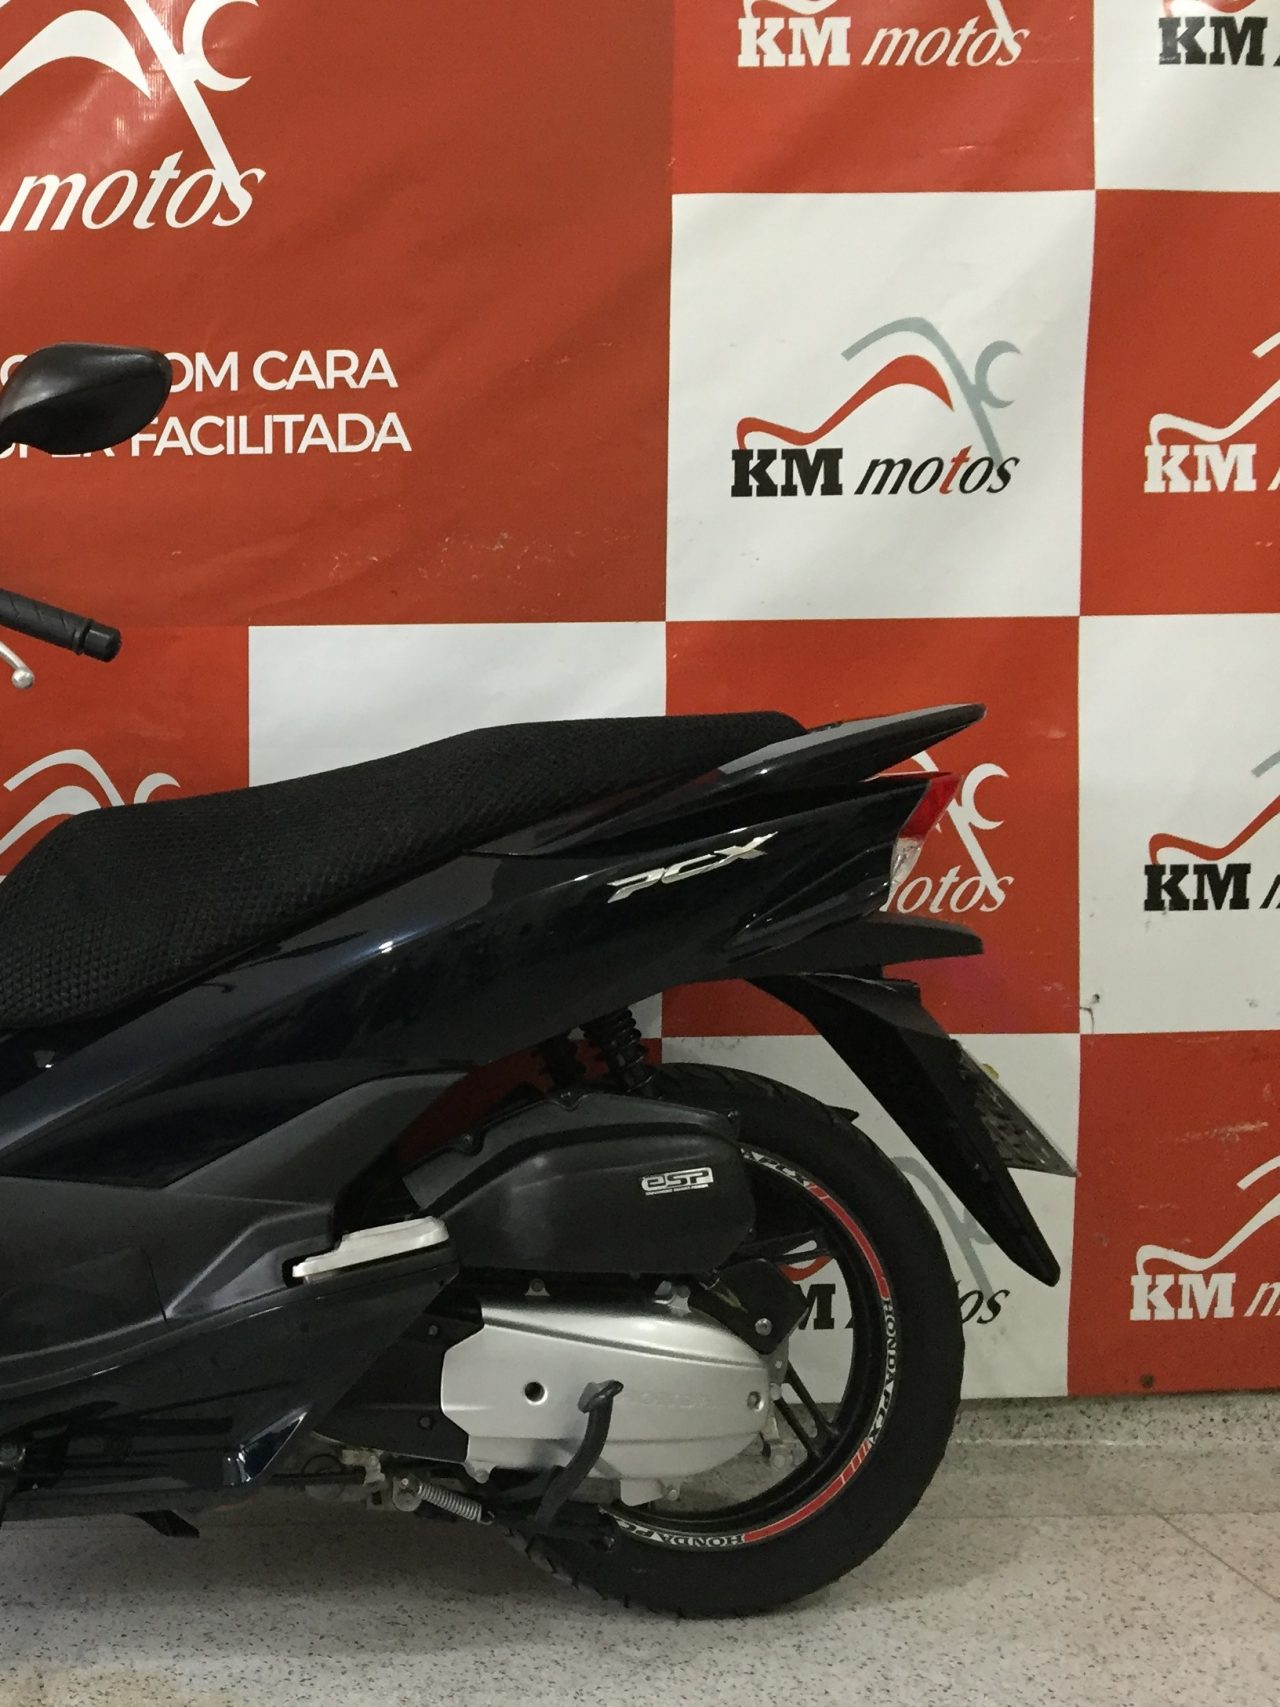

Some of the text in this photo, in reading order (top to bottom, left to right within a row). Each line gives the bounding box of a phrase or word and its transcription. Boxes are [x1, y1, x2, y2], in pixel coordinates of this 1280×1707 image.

[738, 16, 1030, 67] KM motos
[1158, 16, 1268, 66] KM
[252, 348, 399, 391] CARA
[131, 412, 412, 457] FACILITADA
[730, 445, 1020, 497] KM motos
[1144, 443, 1257, 493] KM
[607, 831, 779, 903] PCX
[1144, 863, 1251, 911] KM
[1130, 1272, 1236, 1321] KM
